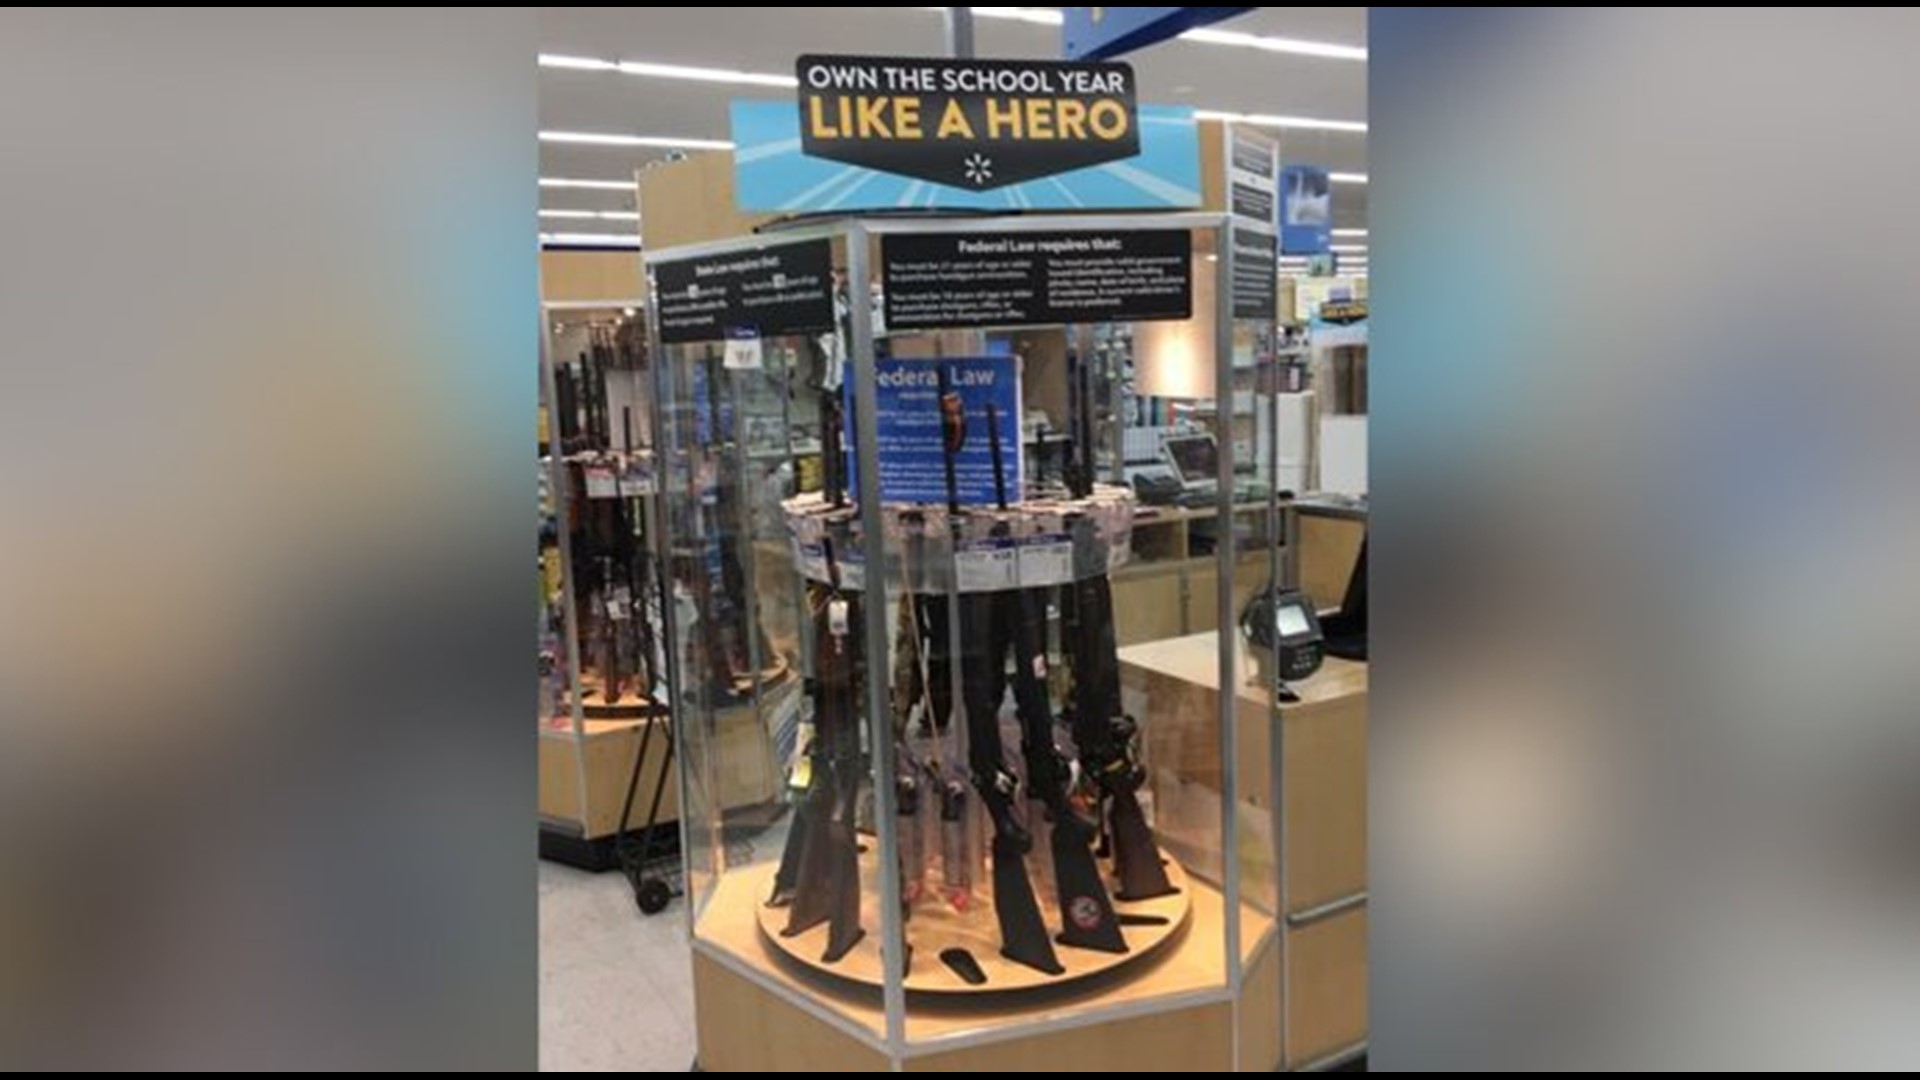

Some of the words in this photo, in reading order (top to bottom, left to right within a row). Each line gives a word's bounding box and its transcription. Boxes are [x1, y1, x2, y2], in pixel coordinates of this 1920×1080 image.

[808, 65, 878, 89] OWN
[883, 67, 937, 91] THE
[942, 69, 1054, 92] SCHOOL
[1058, 71, 1125, 93] YEAR
[809, 96, 924, 139] LIKE
[936, 98, 975, 139] A
[985, 98, 1129, 140] HERO
[957, 239, 1008, 253] Federal
[1008, 239, 1035, 252] Law
[1037, 238, 1090, 254] requires
[875, 365, 942, 387] edera
[950, 365, 995, 386] Law
